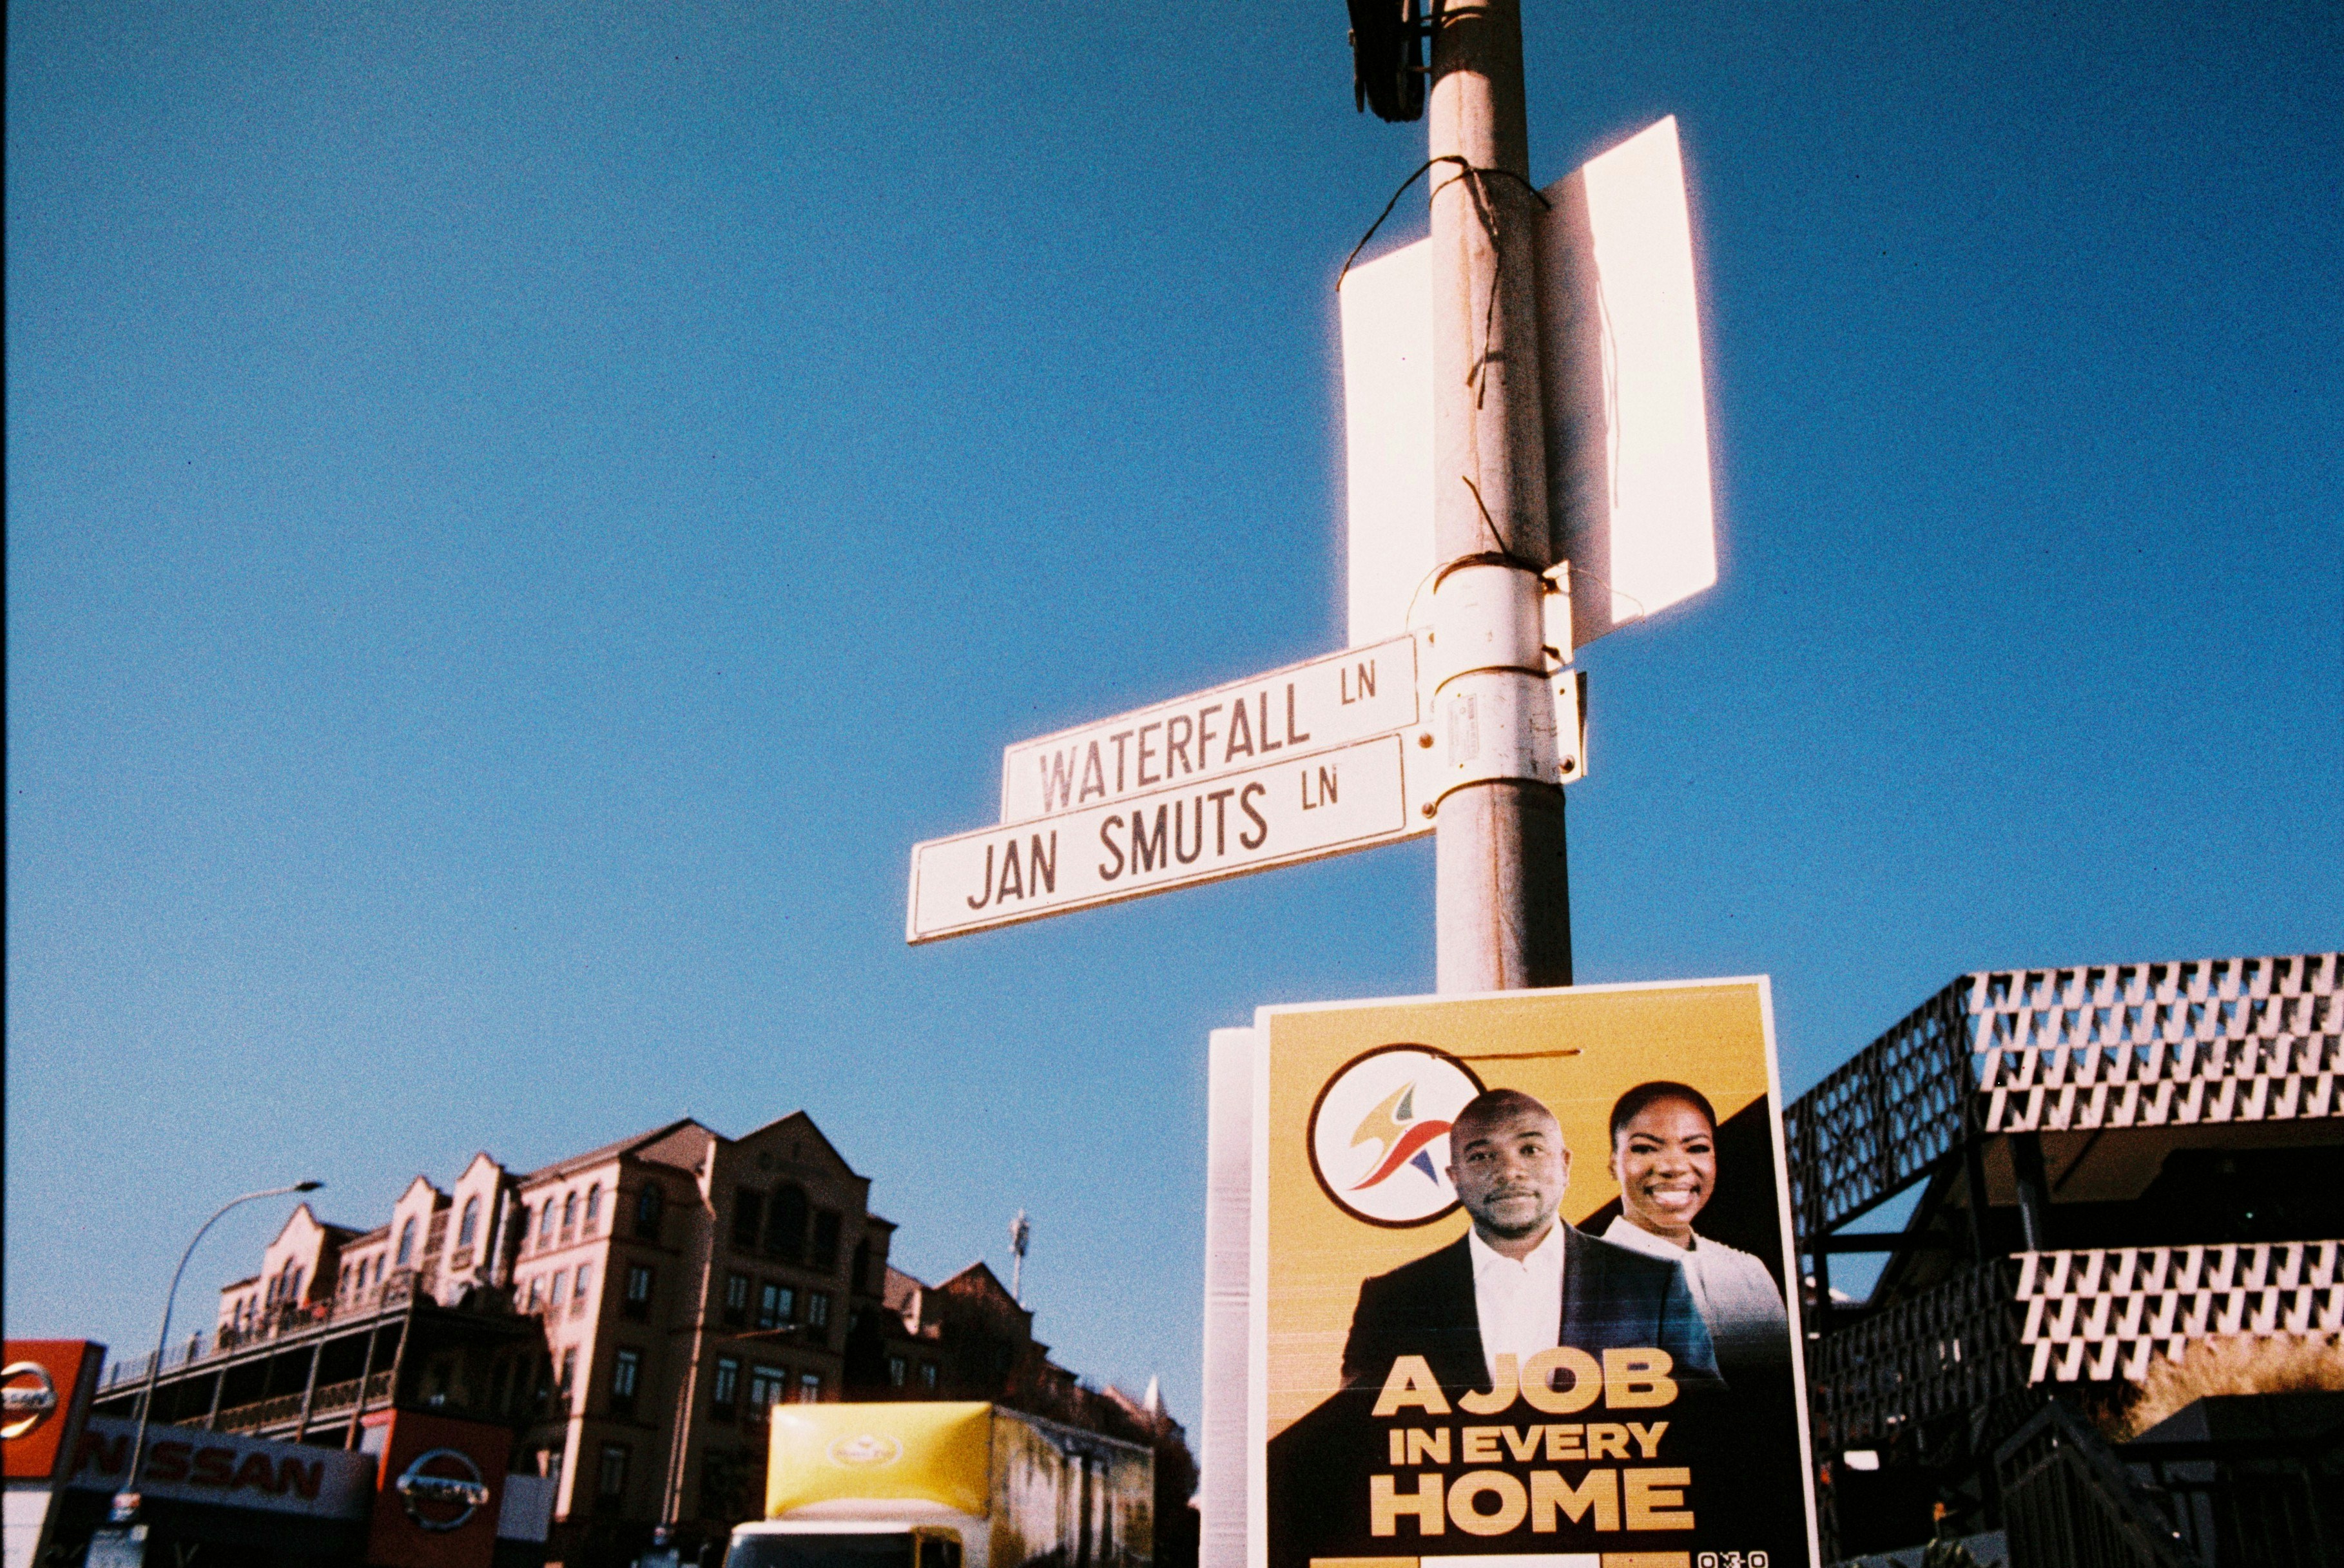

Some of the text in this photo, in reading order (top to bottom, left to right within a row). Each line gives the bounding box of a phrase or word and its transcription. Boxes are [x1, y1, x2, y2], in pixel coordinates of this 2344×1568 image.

[1040, 659, 1376, 813] WATERFALL LN
[967, 765, 1339, 910] JAN SMUTS LN
[1371, 1346, 1679, 1417] A JOB
[1389, 1421, 1670, 1466] IN EVERY
[1370, 1467, 1696, 1537] HOME
